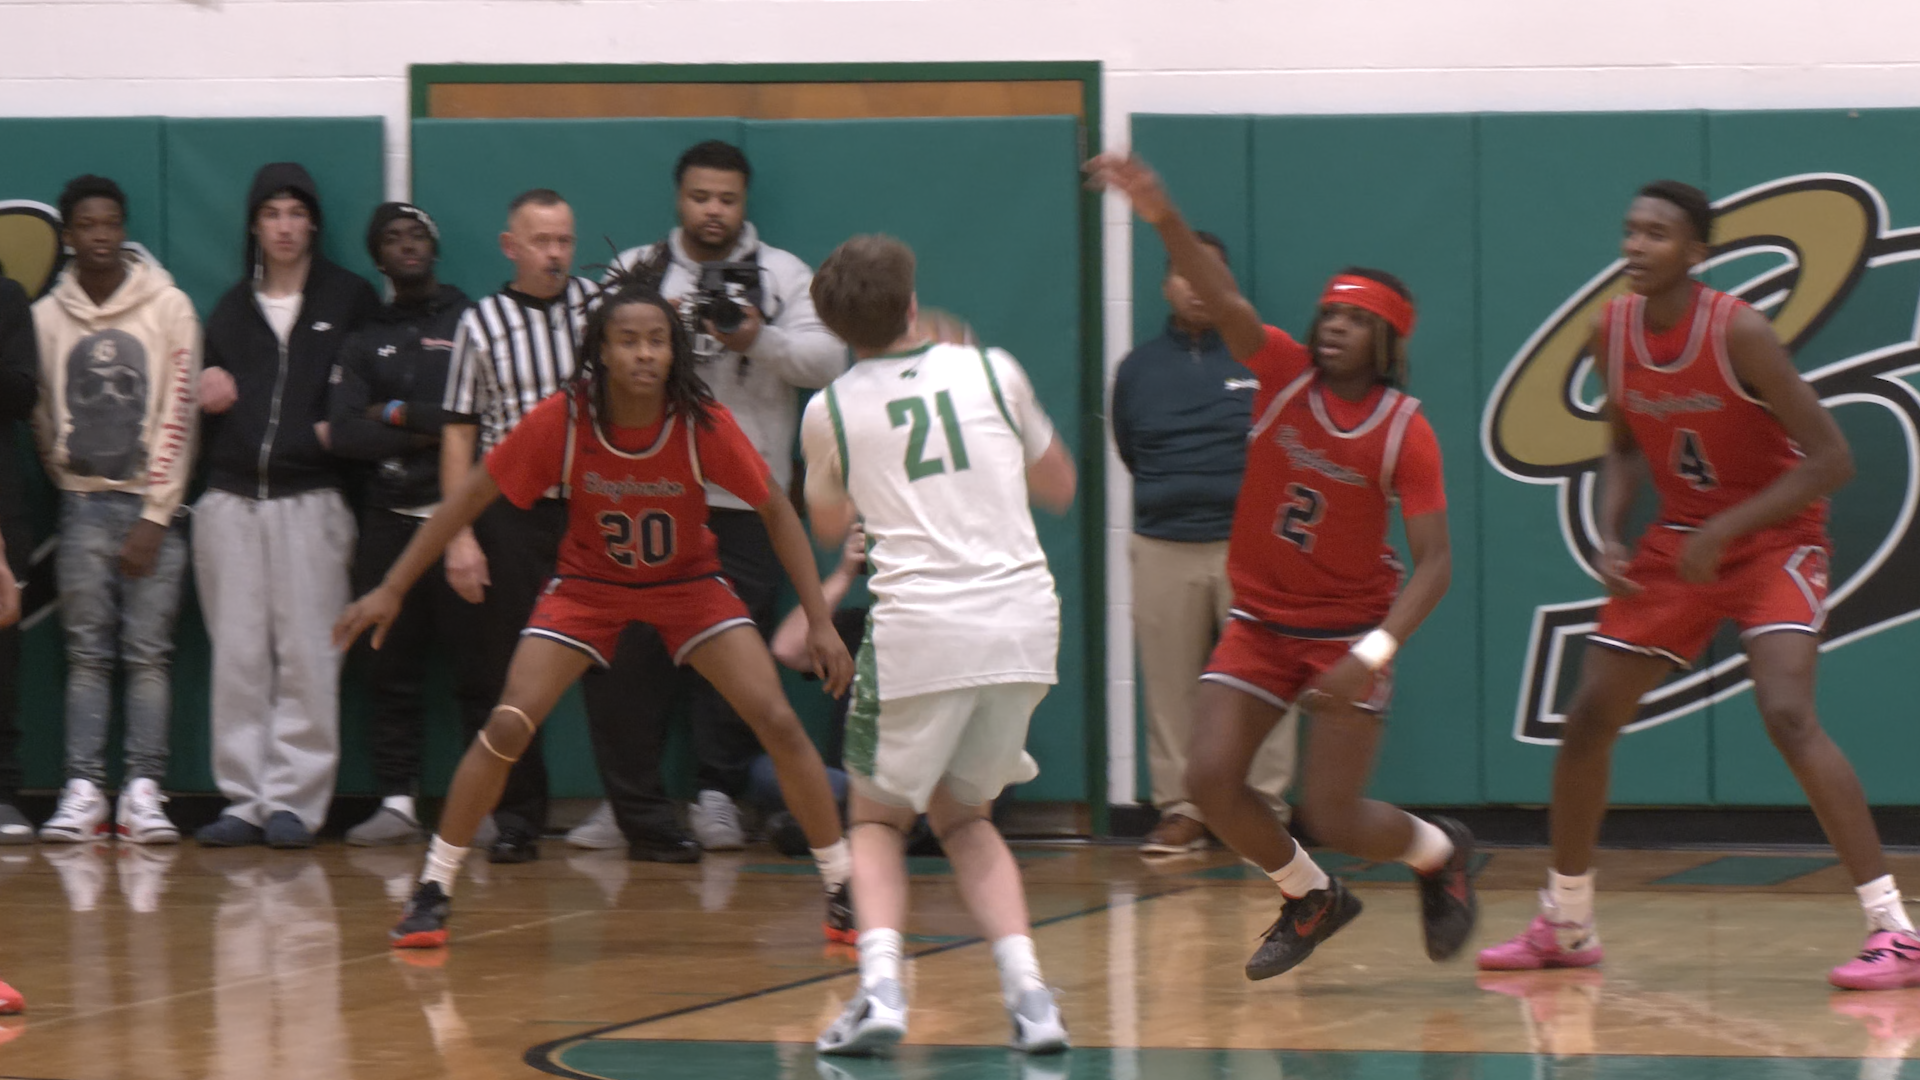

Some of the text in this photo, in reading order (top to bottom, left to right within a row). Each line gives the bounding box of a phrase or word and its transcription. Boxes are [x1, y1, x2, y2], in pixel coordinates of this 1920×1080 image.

[885, 388, 970, 483] 21
[1667, 427, 1719, 492] 4
[596, 508, 677, 569] 20
[1272, 482, 1328, 554] 2
